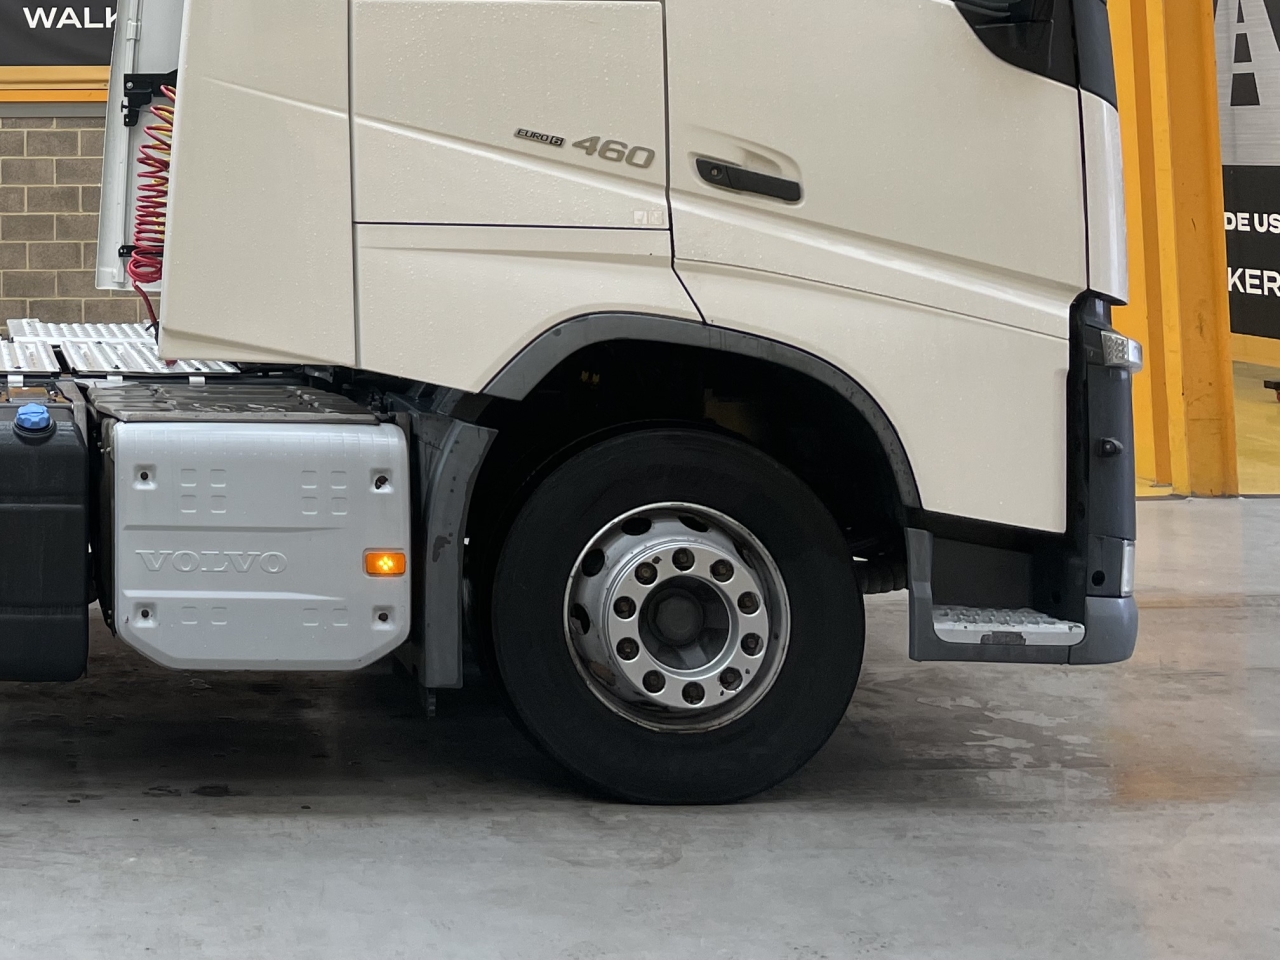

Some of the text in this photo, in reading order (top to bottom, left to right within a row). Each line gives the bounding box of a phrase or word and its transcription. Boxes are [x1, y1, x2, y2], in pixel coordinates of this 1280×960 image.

[572, 135, 655, 168] 460
[1224, 211, 1251, 232] DE
[1227, 266, 1280, 297] KER
[135, 549, 288, 574] VOLVO
